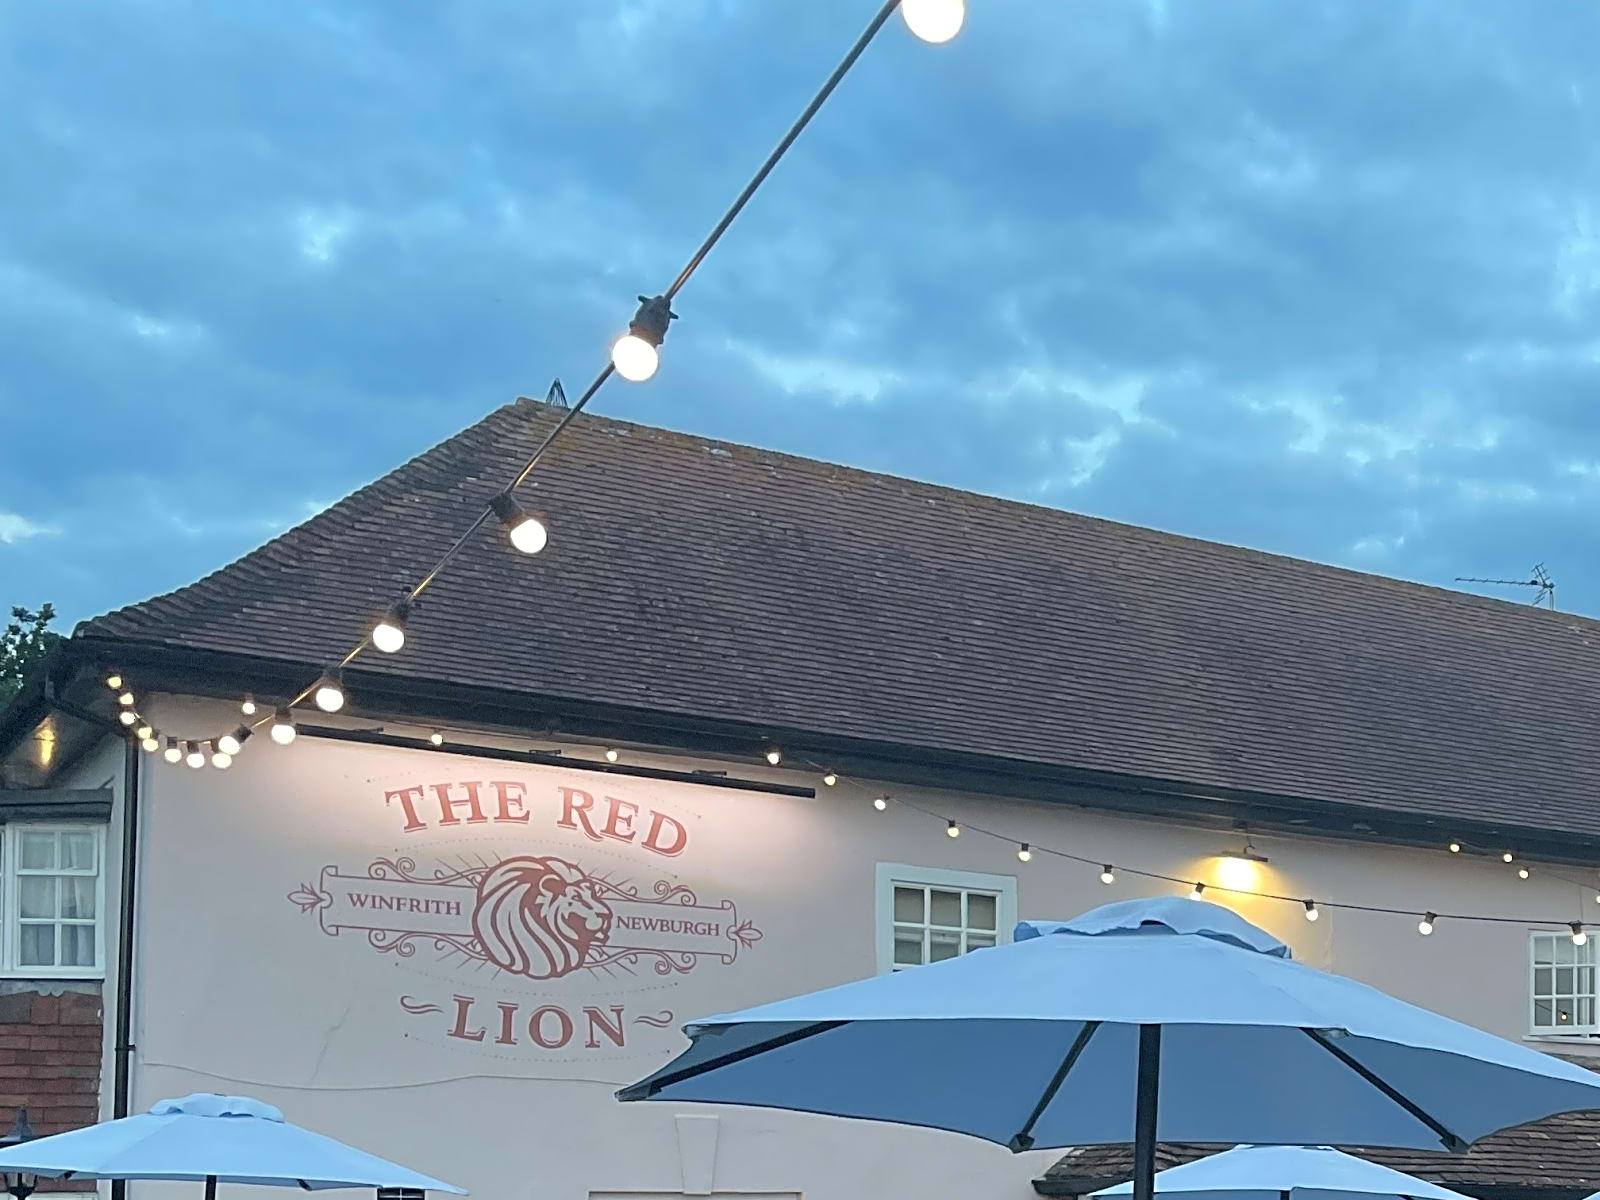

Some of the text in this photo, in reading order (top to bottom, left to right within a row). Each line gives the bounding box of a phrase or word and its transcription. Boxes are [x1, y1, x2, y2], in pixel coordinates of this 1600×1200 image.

[384, 780, 688, 858] THE RED
[346, 891, 721, 937] WINFRITH NEWBURGH
[447, 994, 625, 1049] LION
